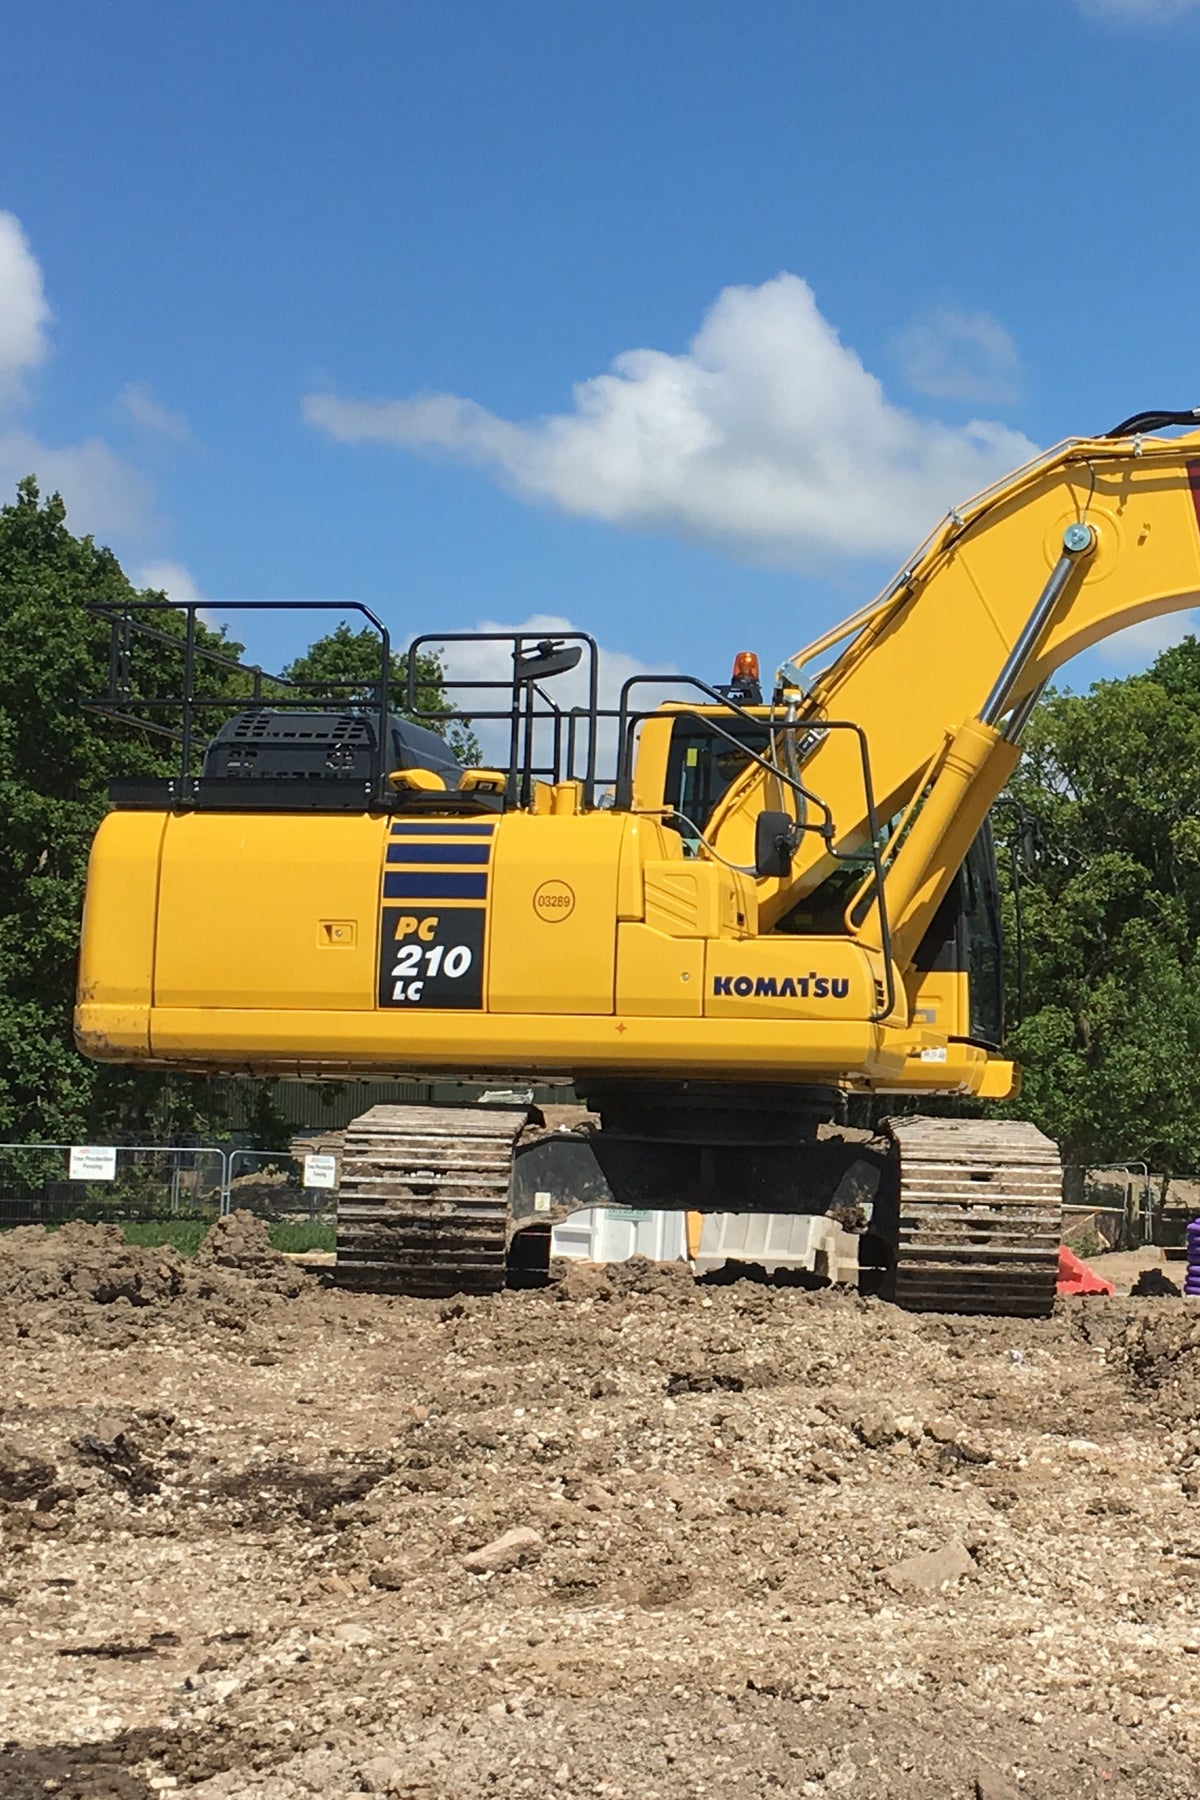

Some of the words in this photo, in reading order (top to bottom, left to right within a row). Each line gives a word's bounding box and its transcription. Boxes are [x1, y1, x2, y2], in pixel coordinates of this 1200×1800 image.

[537, 895, 571, 908] 03289
[394, 916, 439, 942] PC
[391, 944, 472, 978] 210
[392, 981, 424, 1001] LC
[713, 972, 850, 999] KOMATSU
